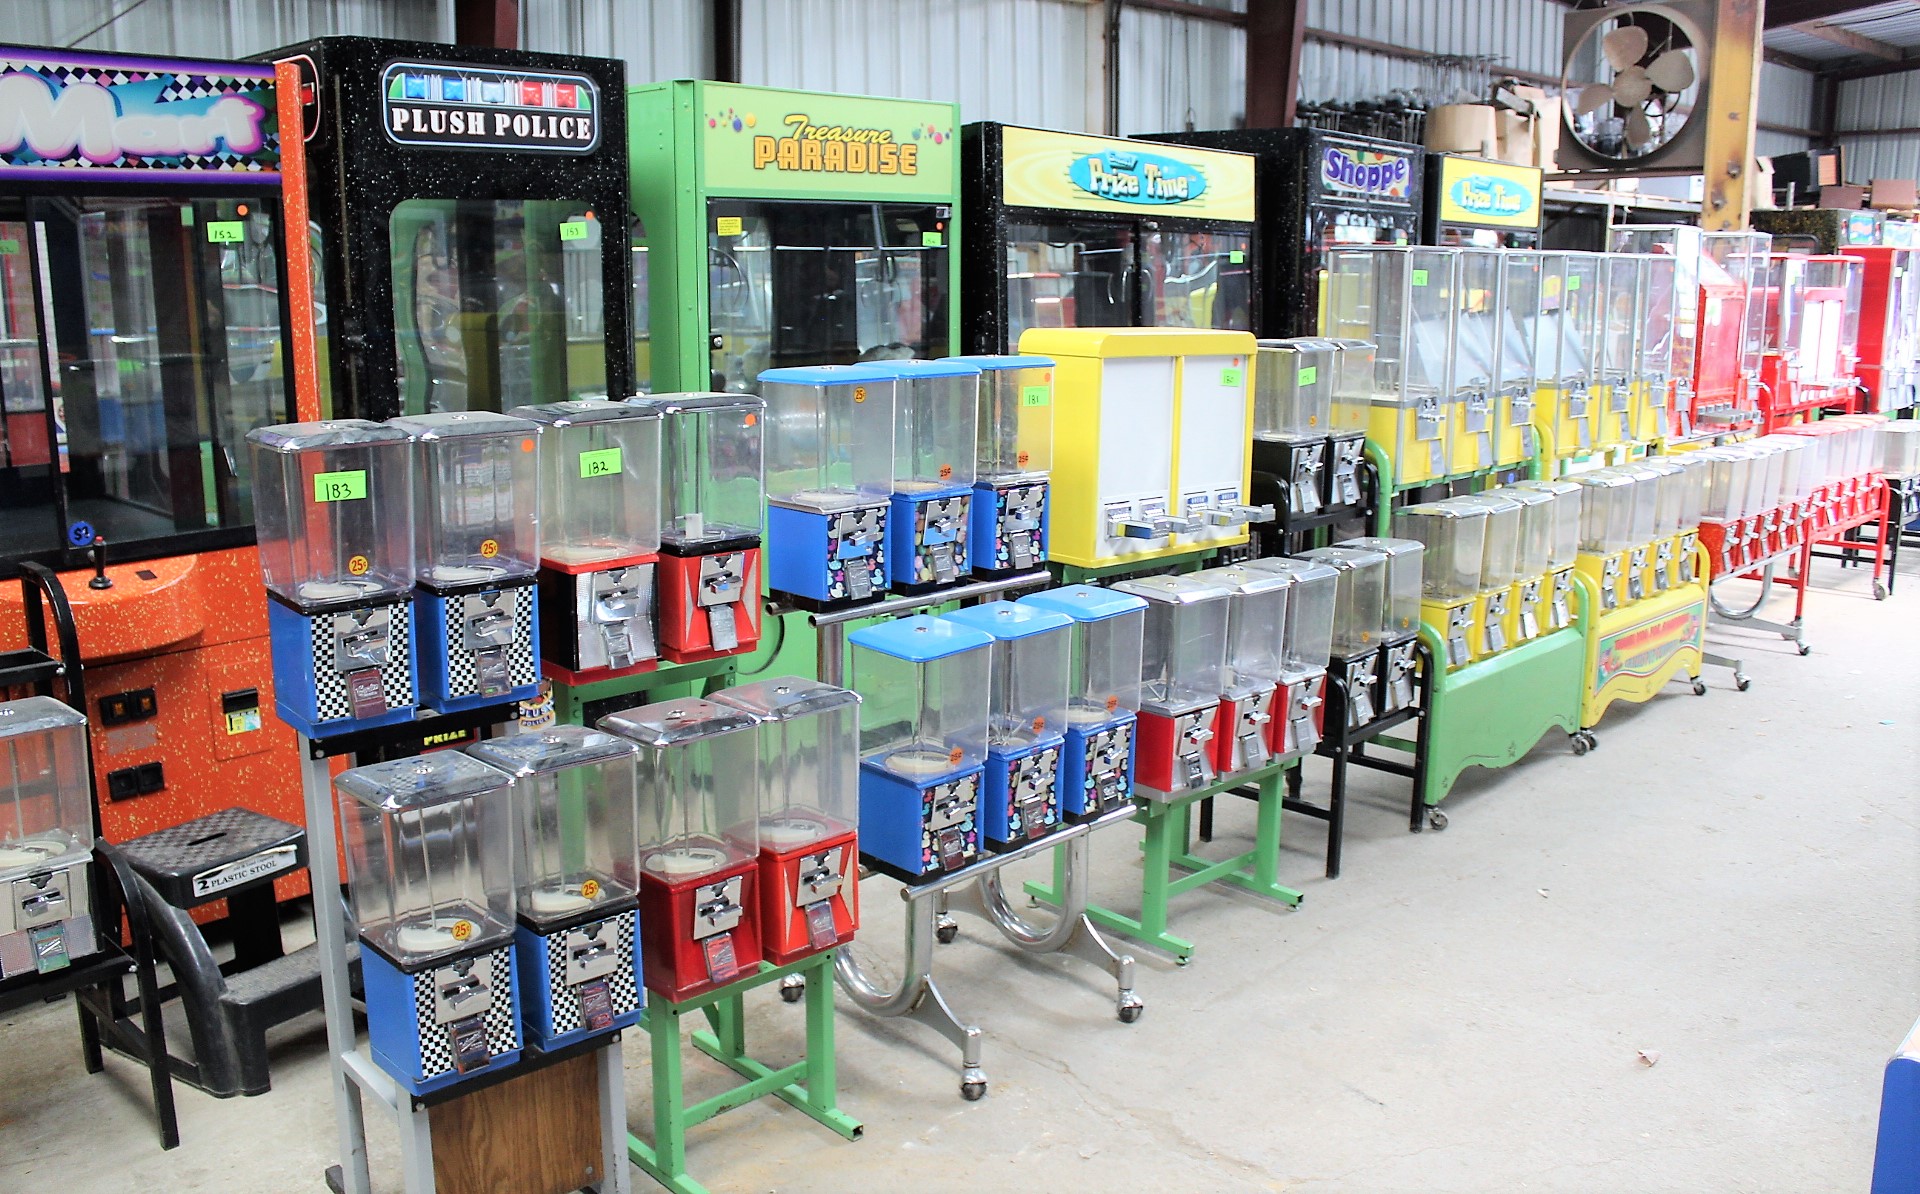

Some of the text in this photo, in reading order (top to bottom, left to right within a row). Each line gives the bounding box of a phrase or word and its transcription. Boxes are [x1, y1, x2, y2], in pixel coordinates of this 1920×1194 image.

[0, 72, 264, 163] Mart
[391, 106, 592, 140] PLUSH POLICE
[784, 114, 892, 144] Treasure
[754, 136, 918, 175] PARADISE
[1326, 149, 1406, 192] Shoppe
[1088, 157, 1189, 200] Prize Time
[214, 230, 237, 240] 152
[588, 461, 609, 474] 182
[325, 482, 352, 501] 183
[198, 880, 210, 891] 2
[211, 869, 248, 888] PLASTIC
[249, 860, 278, 876] STOOL
